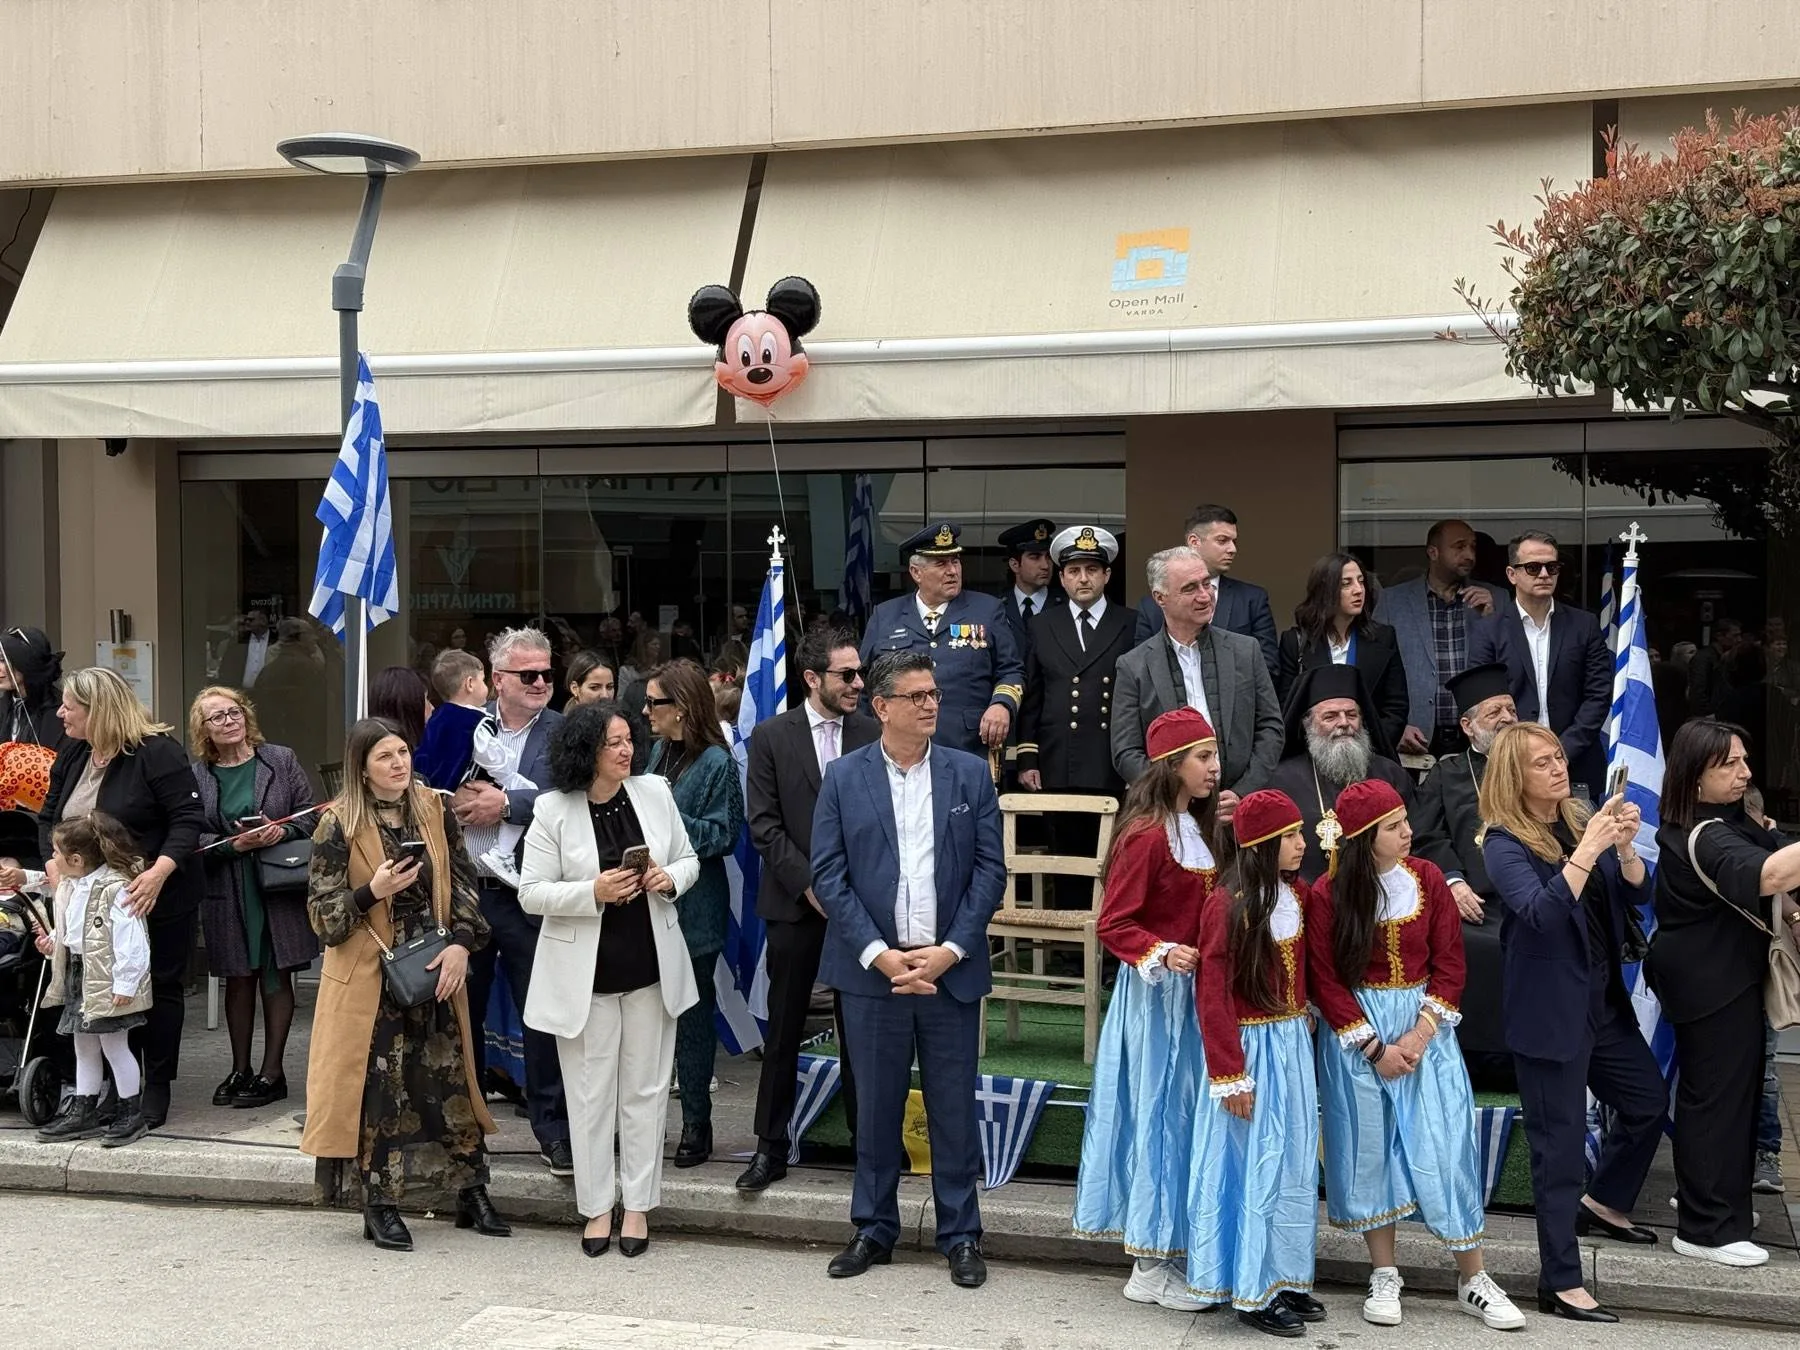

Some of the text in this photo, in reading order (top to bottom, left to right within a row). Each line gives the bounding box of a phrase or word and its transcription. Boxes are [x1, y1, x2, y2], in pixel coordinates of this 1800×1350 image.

[1108, 293, 1184, 309] Open Mall
[1126, 308, 1164, 316] VARDA
